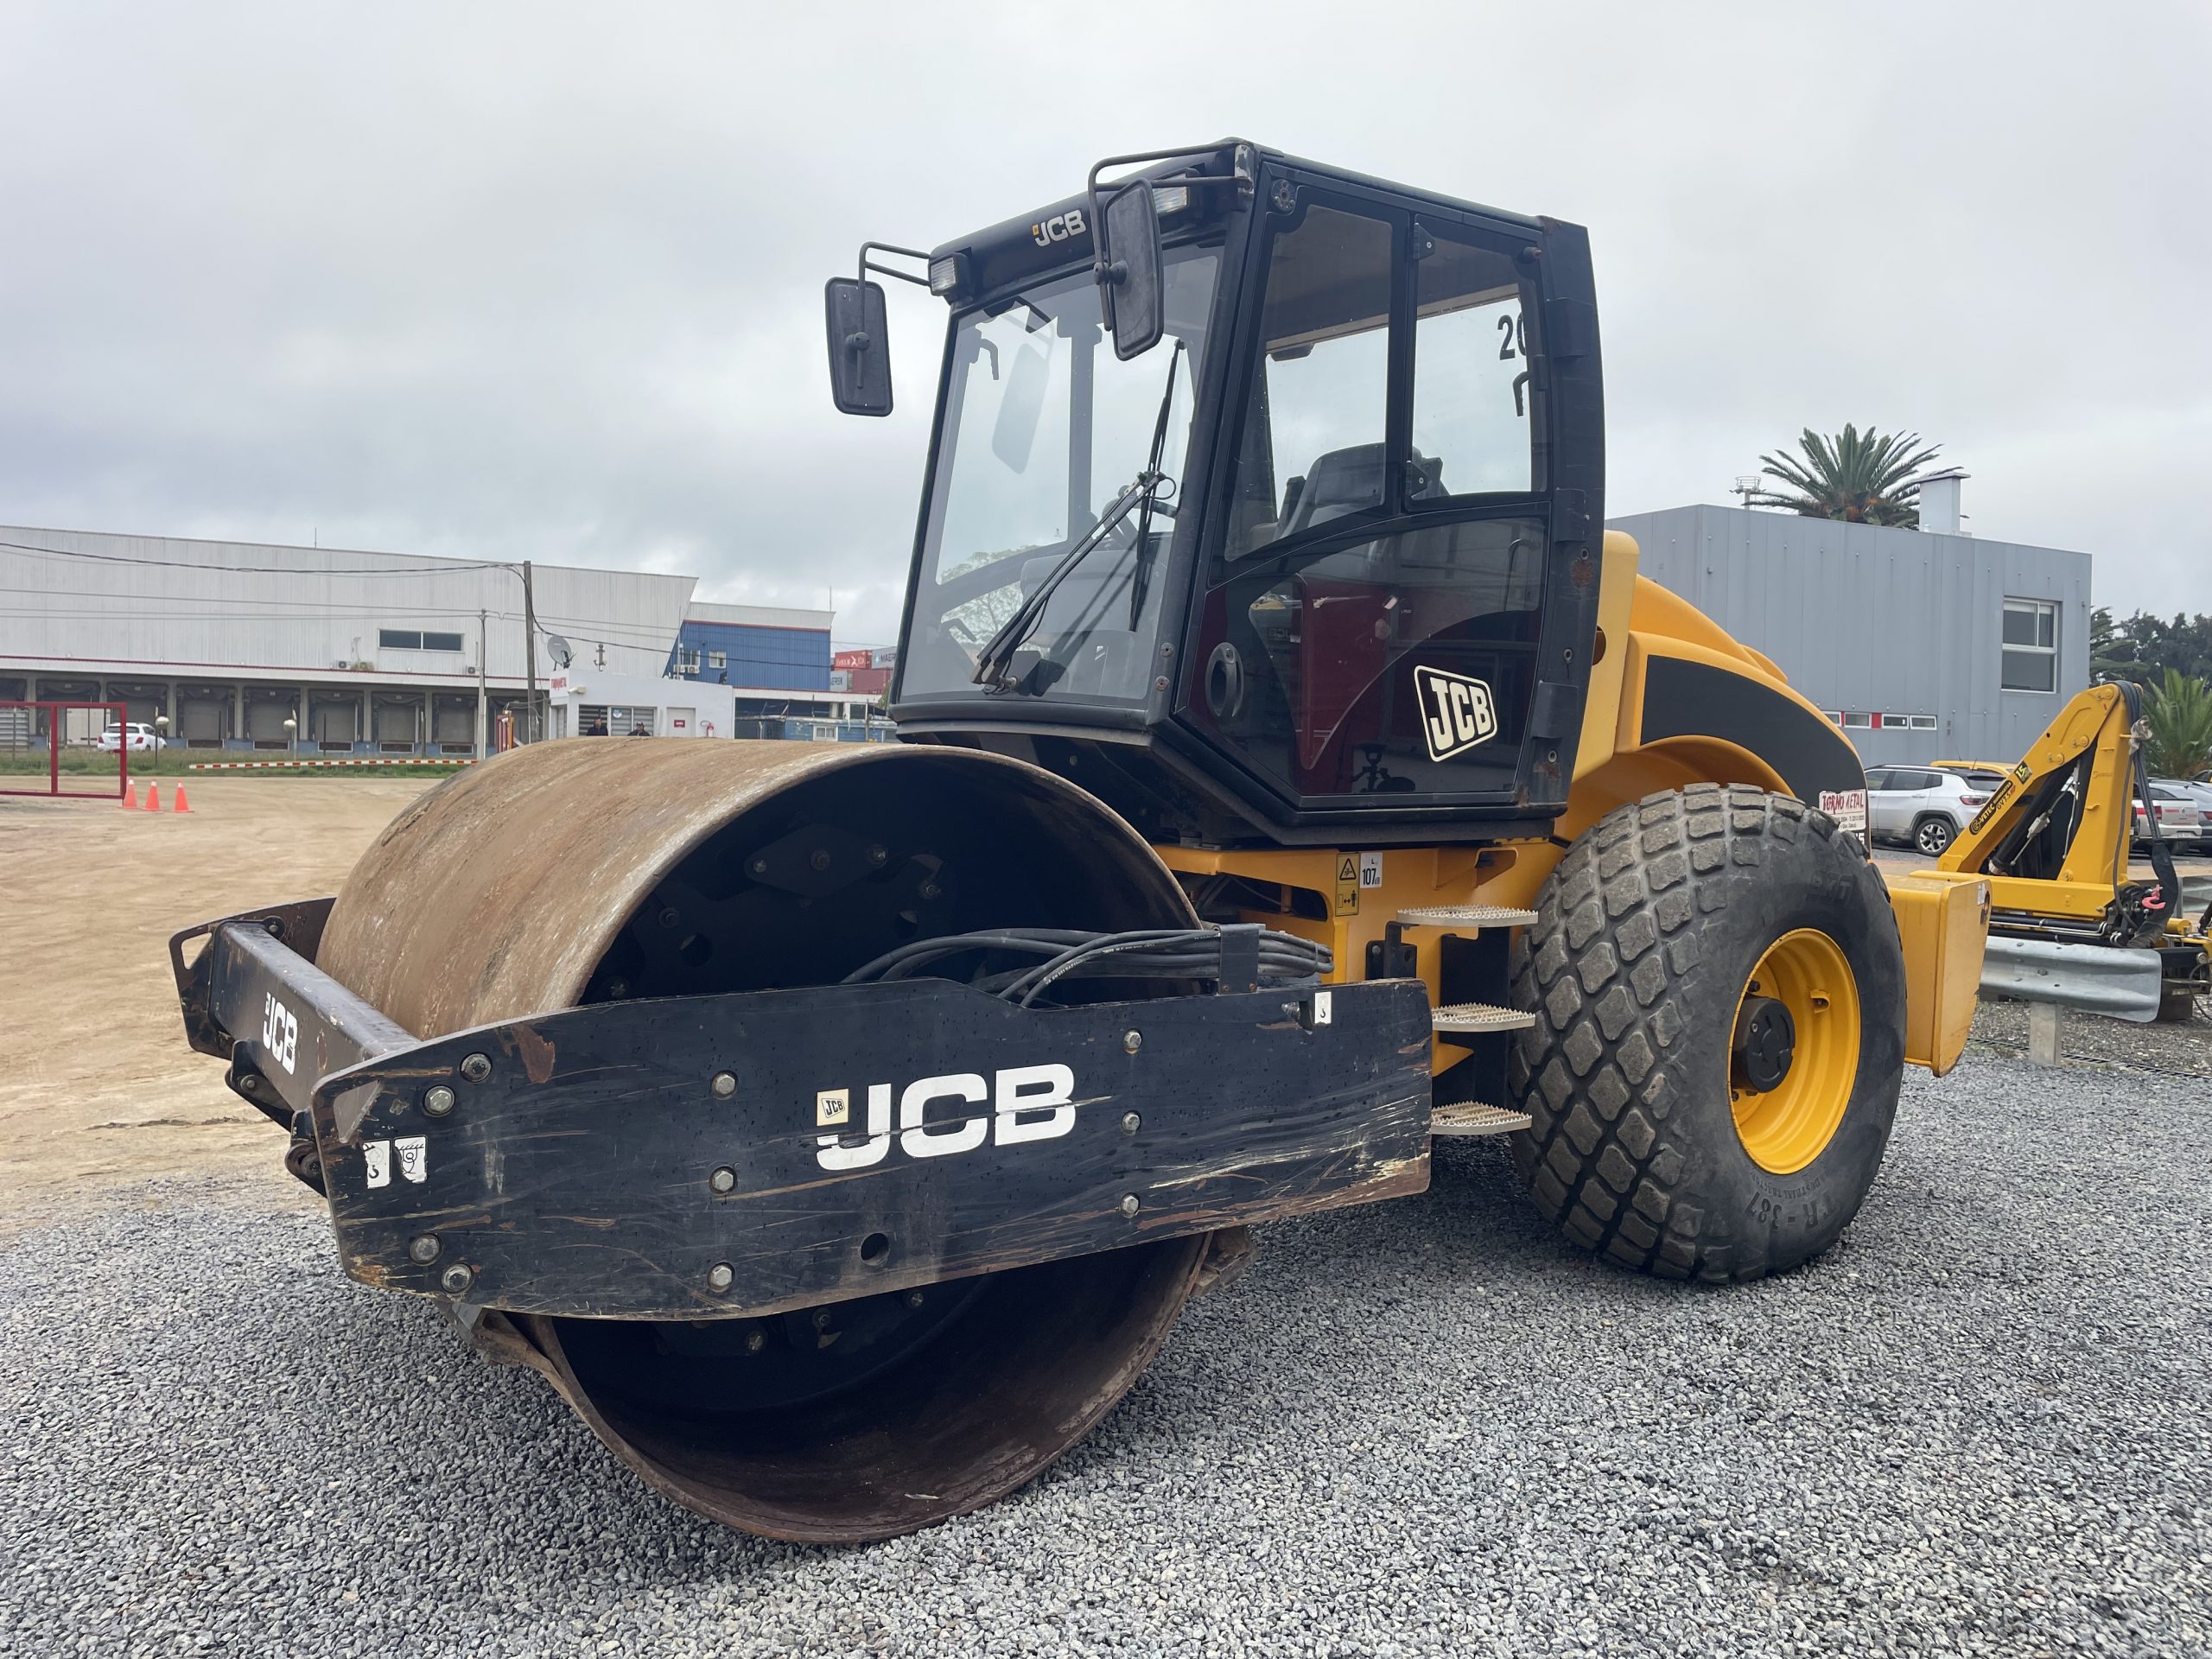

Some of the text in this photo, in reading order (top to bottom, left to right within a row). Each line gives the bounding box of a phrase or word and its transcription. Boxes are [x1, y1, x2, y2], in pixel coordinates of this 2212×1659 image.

[1033, 210, 1087, 247] JCB
[1429, 677, 1491, 751] JCB
[1822, 794, 1845, 815] TORNO
[1362, 868, 1376, 886] 107
[263, 991, 298, 1076] JCB
[816, 1063, 1077, 1171] JCB
[825, 1099, 843, 1116] JCB
